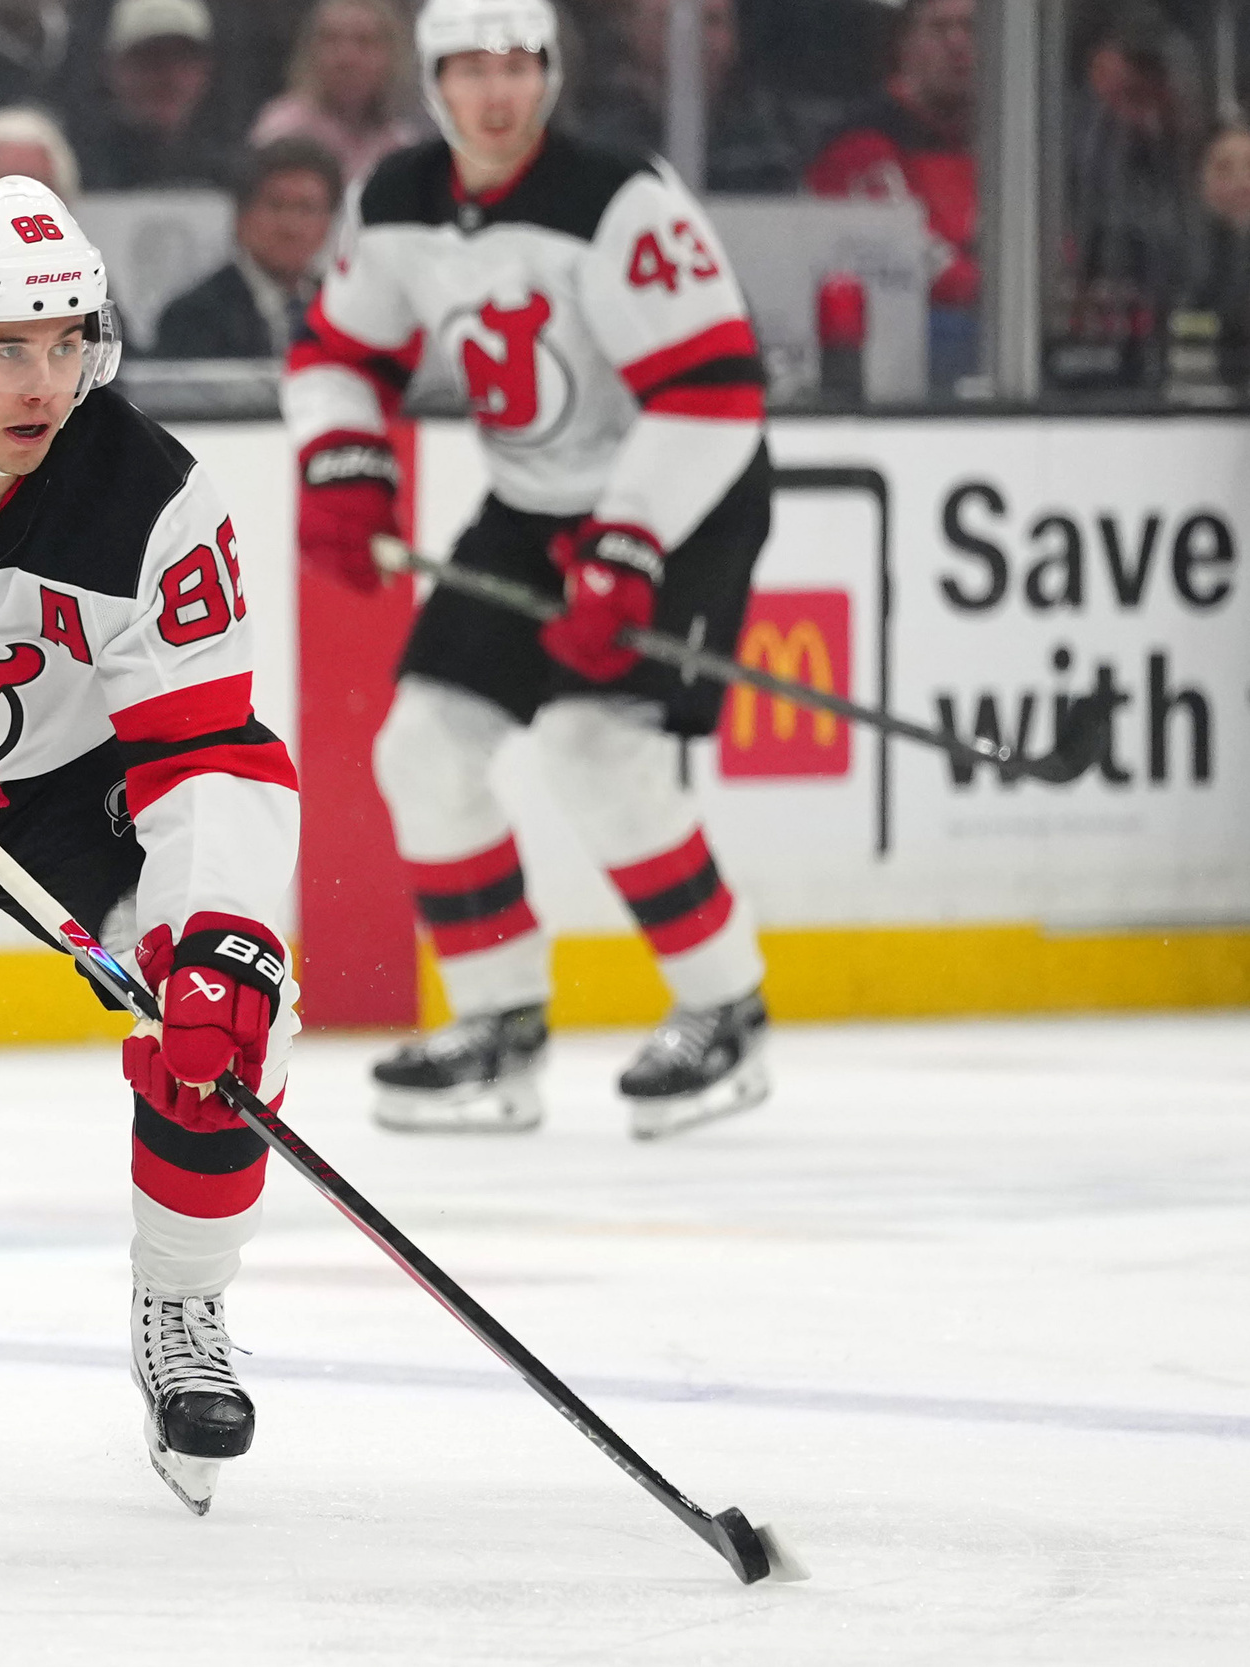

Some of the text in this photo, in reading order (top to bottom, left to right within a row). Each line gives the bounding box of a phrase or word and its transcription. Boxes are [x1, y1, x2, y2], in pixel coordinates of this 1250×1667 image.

[11, 214, 64, 244] 86
[626, 219, 720, 293] 43
[940, 482, 1235, 610] Save
[40, 584, 93, 666] A
[936, 645, 1212, 786] with
